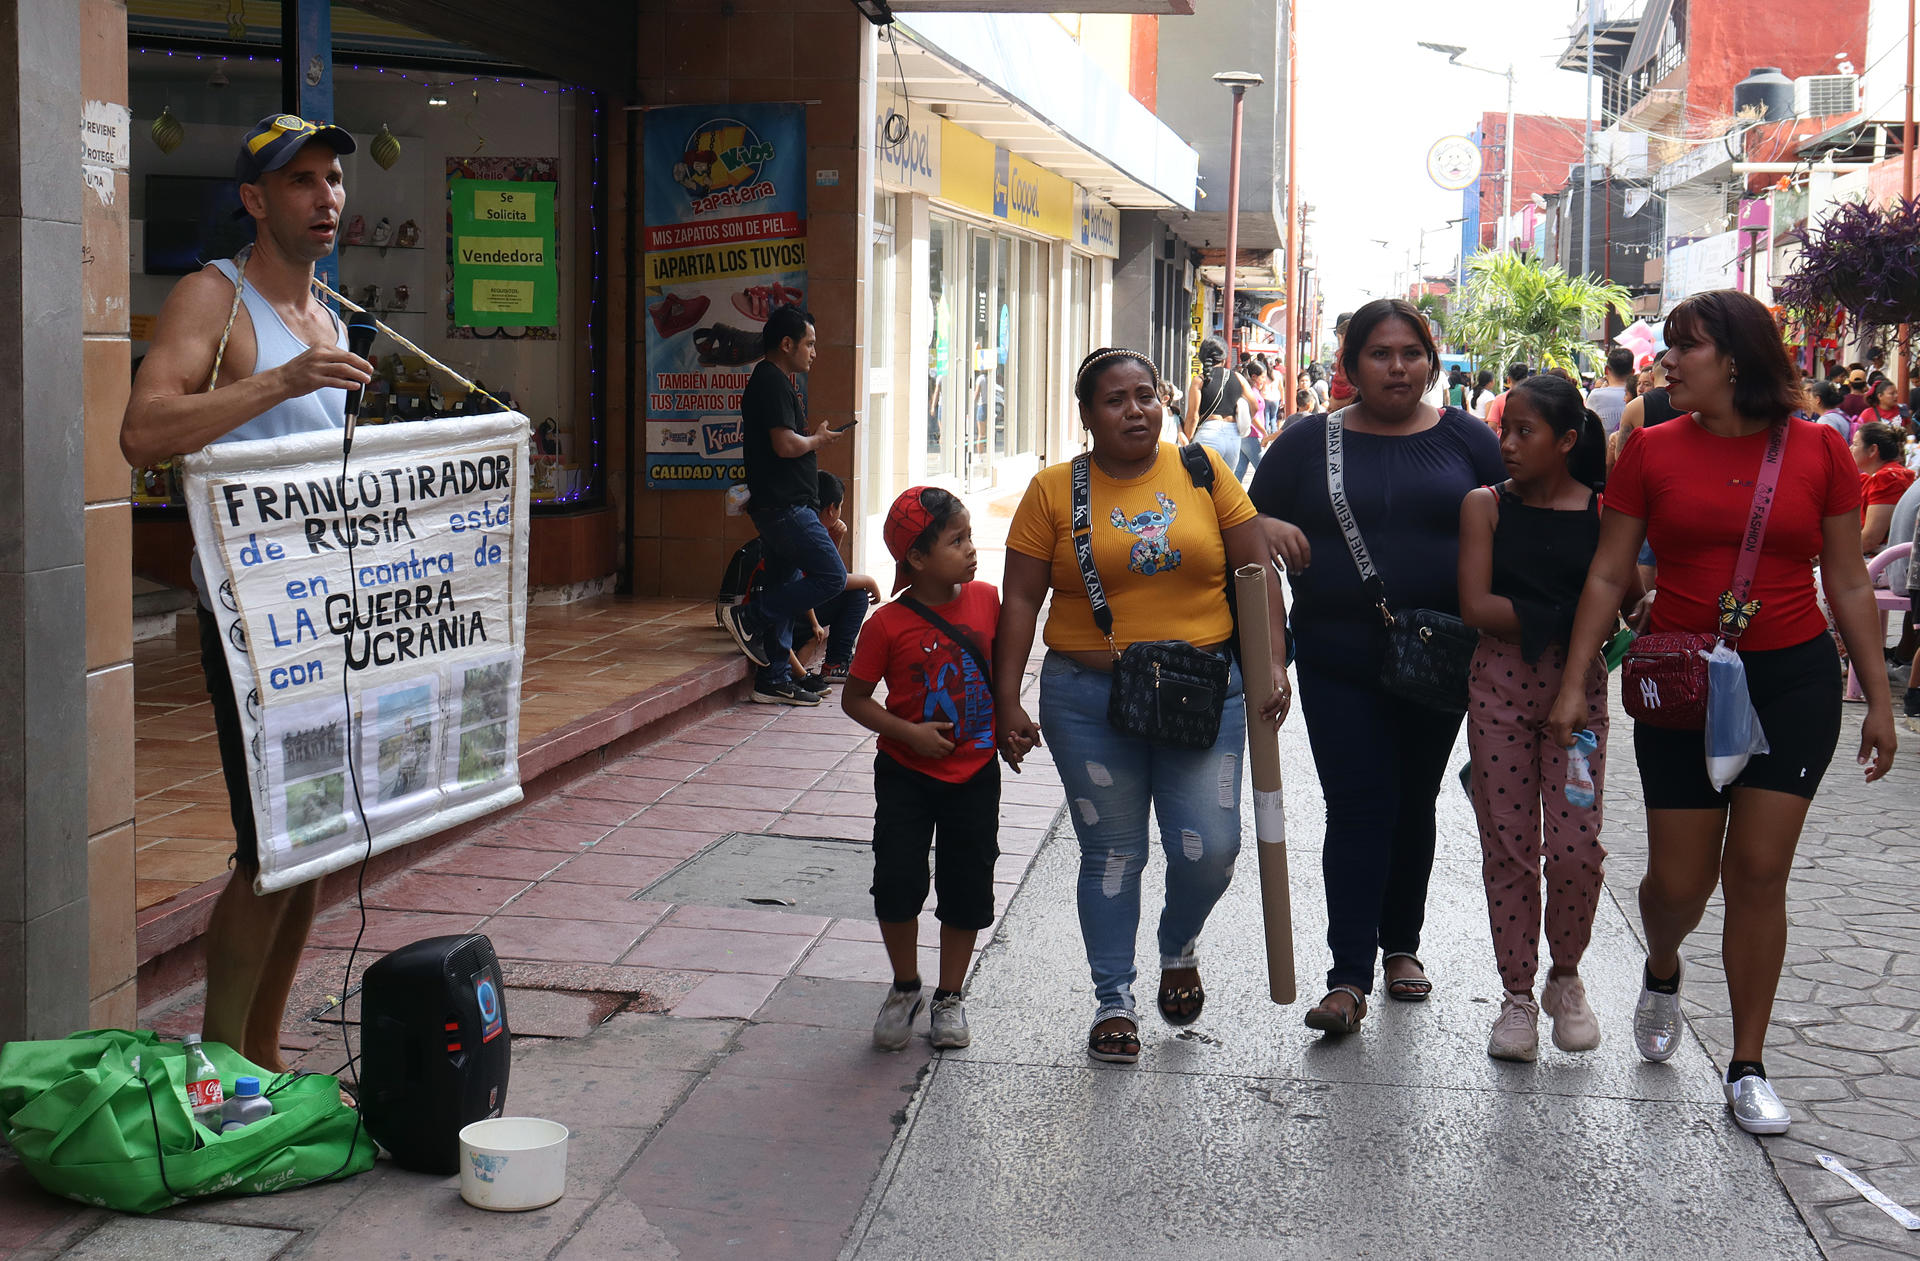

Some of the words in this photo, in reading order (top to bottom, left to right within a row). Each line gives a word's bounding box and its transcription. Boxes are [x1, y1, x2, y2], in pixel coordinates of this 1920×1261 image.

[875, 107, 932, 186] nCoppel
[500, 192, 514, 203] Se
[1011, 168, 1040, 225] Coppel
[486, 208, 527, 221] Solicita
[652, 231, 673, 246] MIS
[675, 225, 719, 244] ZAPATOS
[722, 222, 744, 238] SON
[746, 220, 760, 234] DE
[462, 249, 543, 263] Vendedora
[719, 249, 748, 272] LOS
[658, 371, 707, 390] TAMBIÉN
[651, 395, 673, 411] TUS
[676, 394, 724, 410] ZAPATOS
[650, 465, 713, 480] CALIDAD
[714, 466, 727, 479] Y
[239, 533, 286, 567] de
[449, 494, 510, 533] está
[1744, 505, 1765, 553] FASHION
[286, 575, 329, 599] en
[358, 549, 454, 587] contra
[474, 536, 502, 567] de
[268, 608, 319, 648] LA
[325, 579, 456, 635] GUERRA
[270, 660, 324, 690] con
